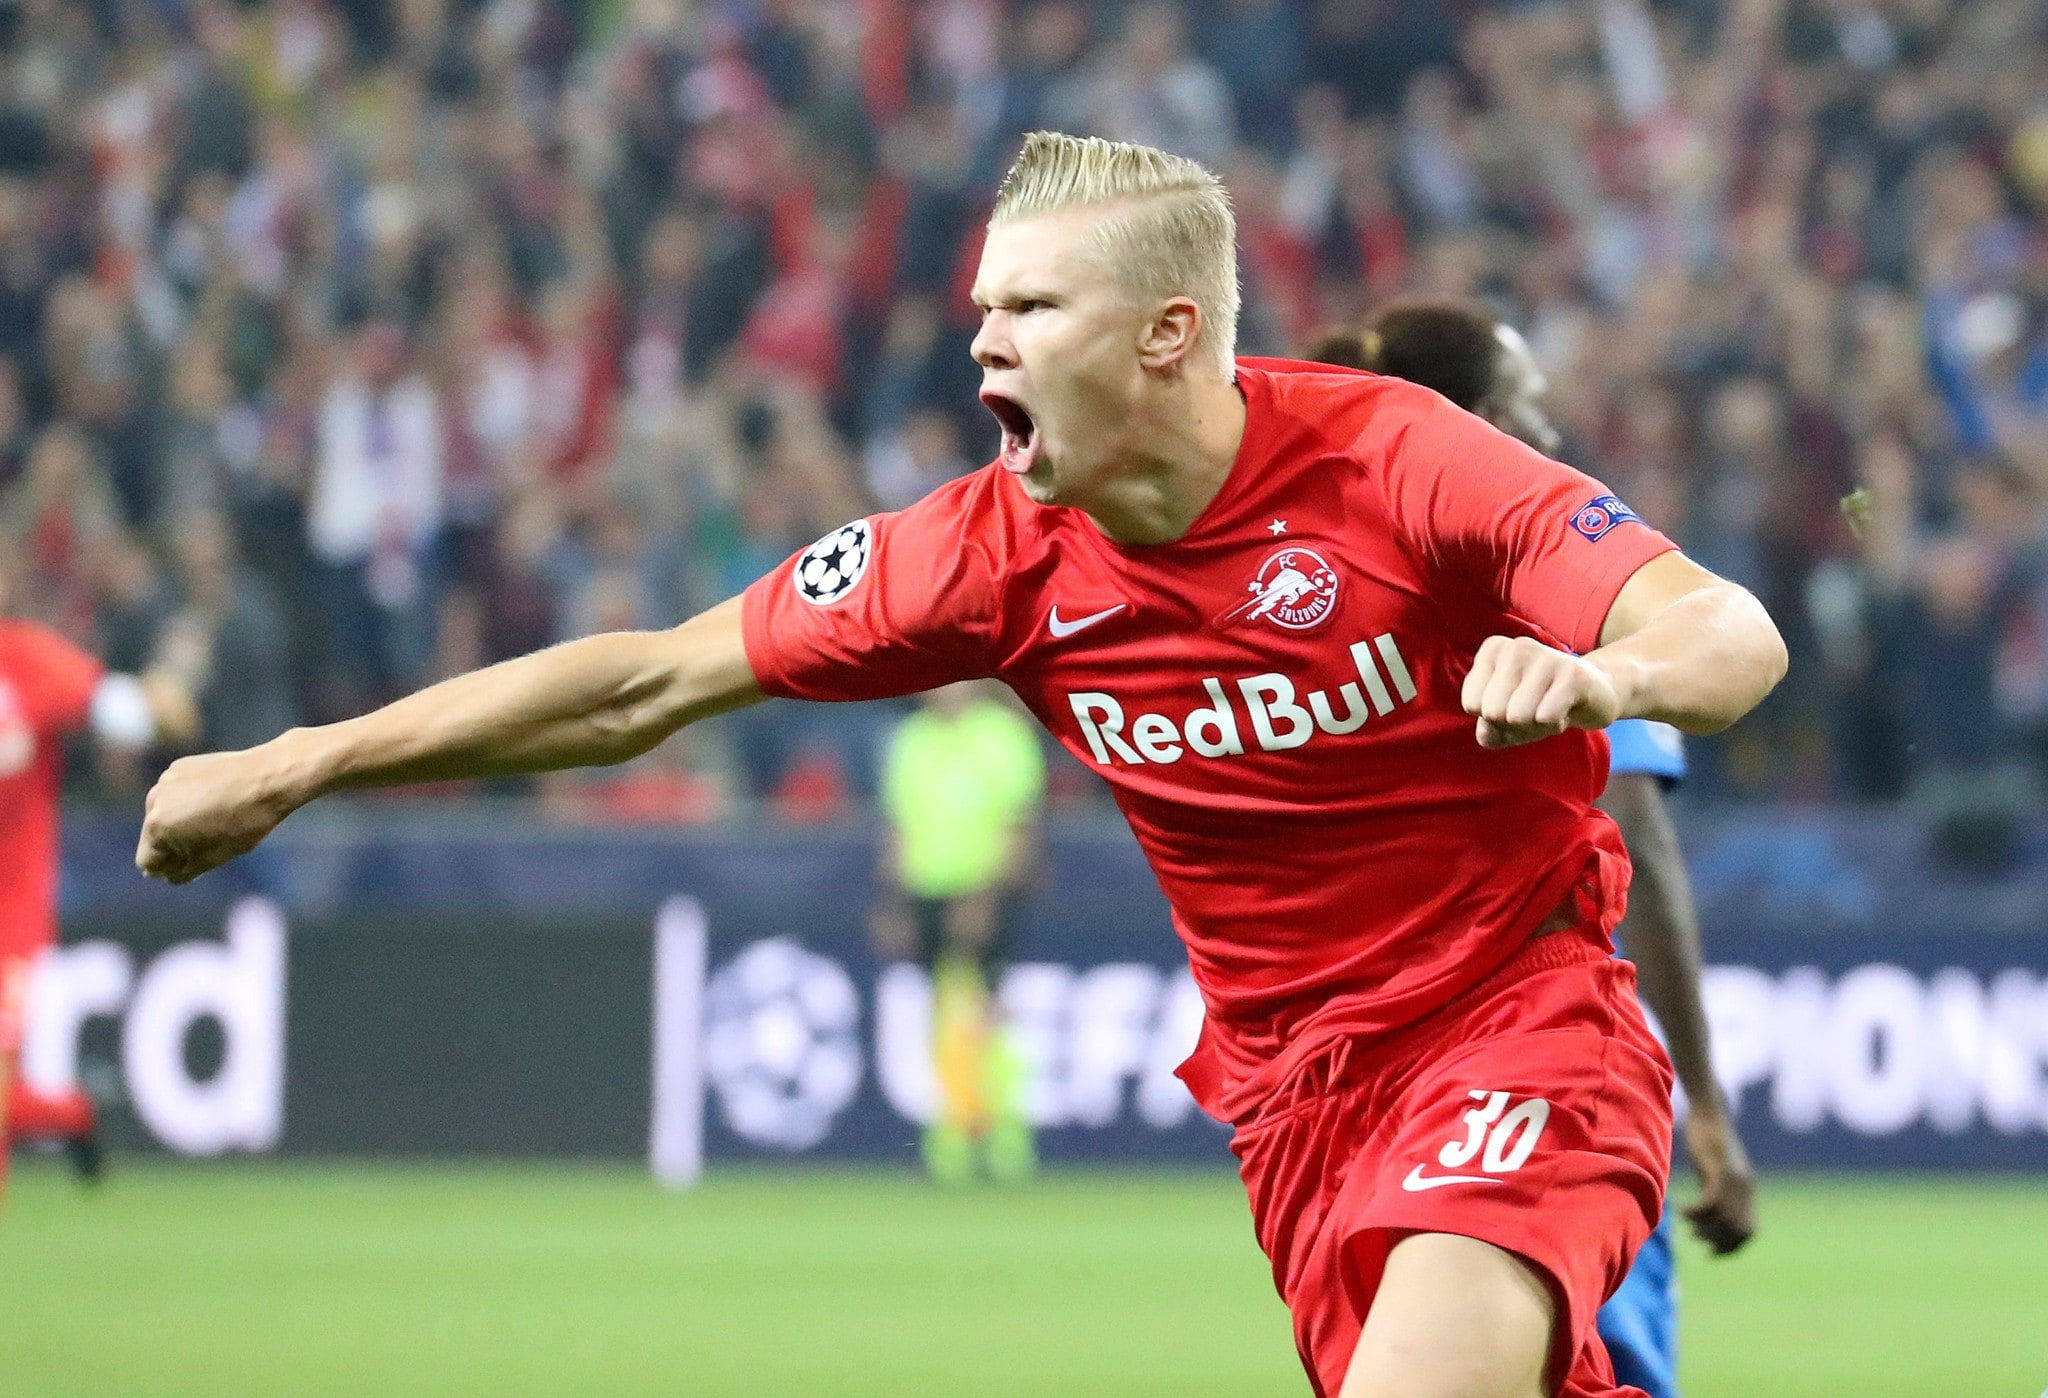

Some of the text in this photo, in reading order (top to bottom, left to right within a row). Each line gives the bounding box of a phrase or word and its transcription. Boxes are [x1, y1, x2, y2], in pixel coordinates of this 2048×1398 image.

[1278, 553, 1297, 569] FC
[1278, 597, 1328, 622] SALZBURG
[1068, 632, 1418, 764] Red Bull
[1644, 963, 2048, 1136] PION
[1438, 1089, 1550, 1173] 30
